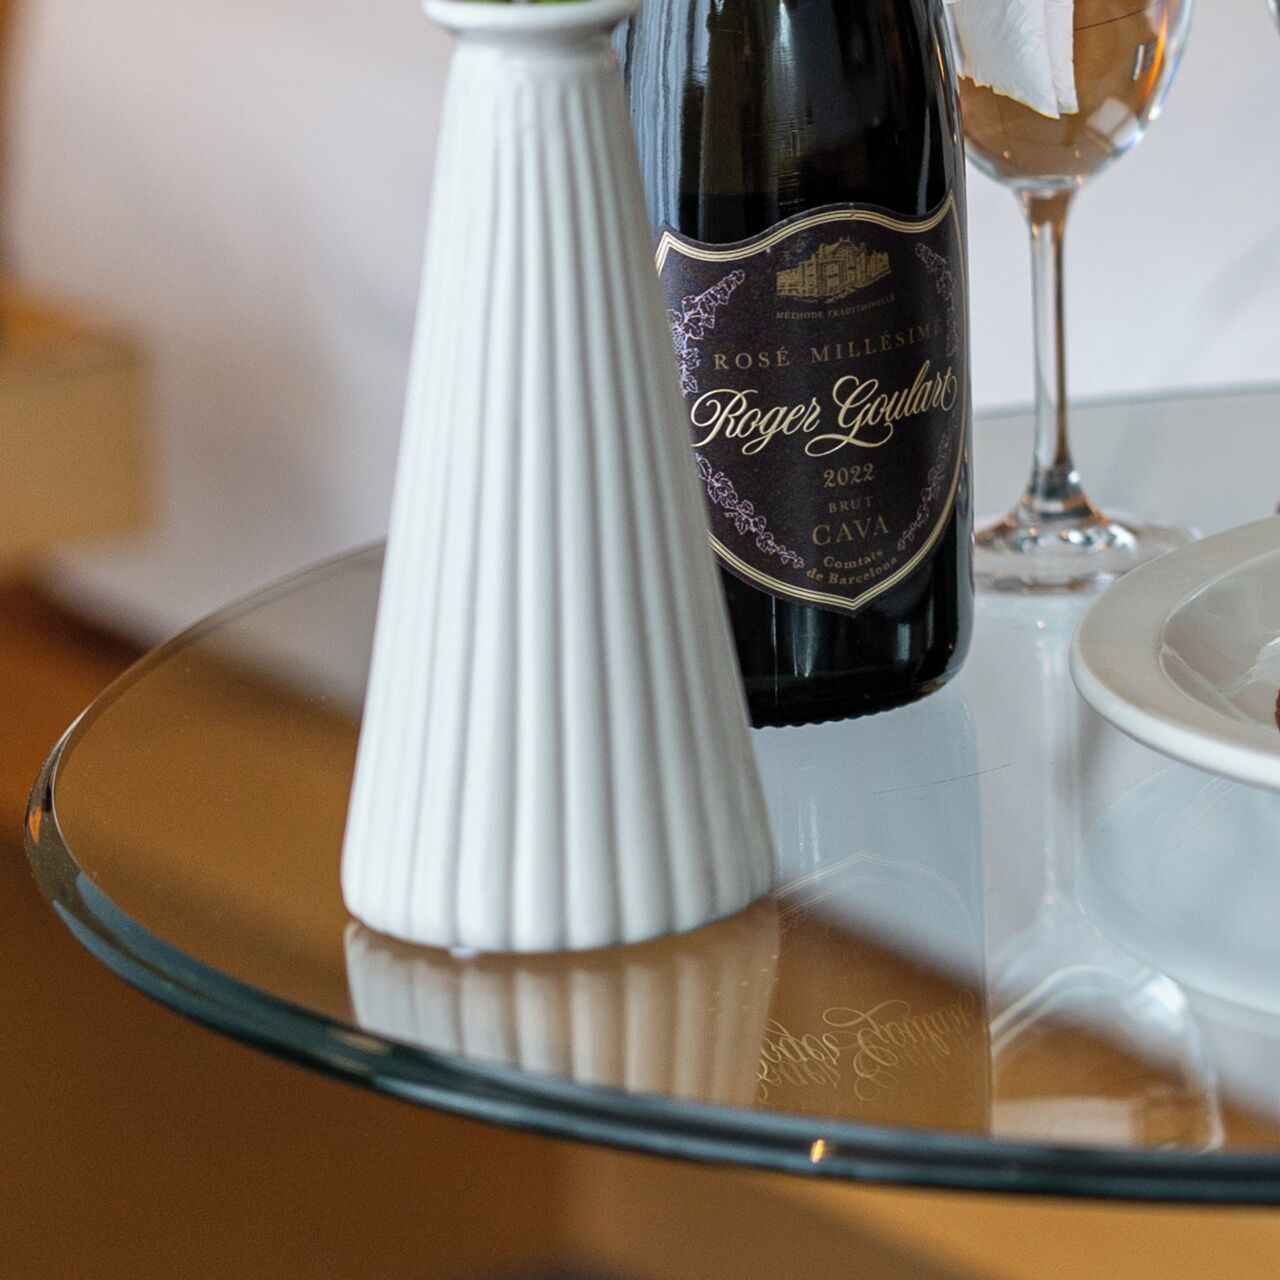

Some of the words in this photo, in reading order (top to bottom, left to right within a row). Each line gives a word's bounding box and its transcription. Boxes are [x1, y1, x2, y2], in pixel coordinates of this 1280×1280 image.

[714, 344, 790, 371] ROSÉ
[690, 388, 821, 455] Roger
[805, 359, 958, 457] Goulart
[823, 463, 876, 489] 2022
[828, 496, 874, 514] BRUT
[812, 515, 890, 547] CAVA
[806, 567, 824, 581] de
[829, 556, 899, 585] Barcelona
